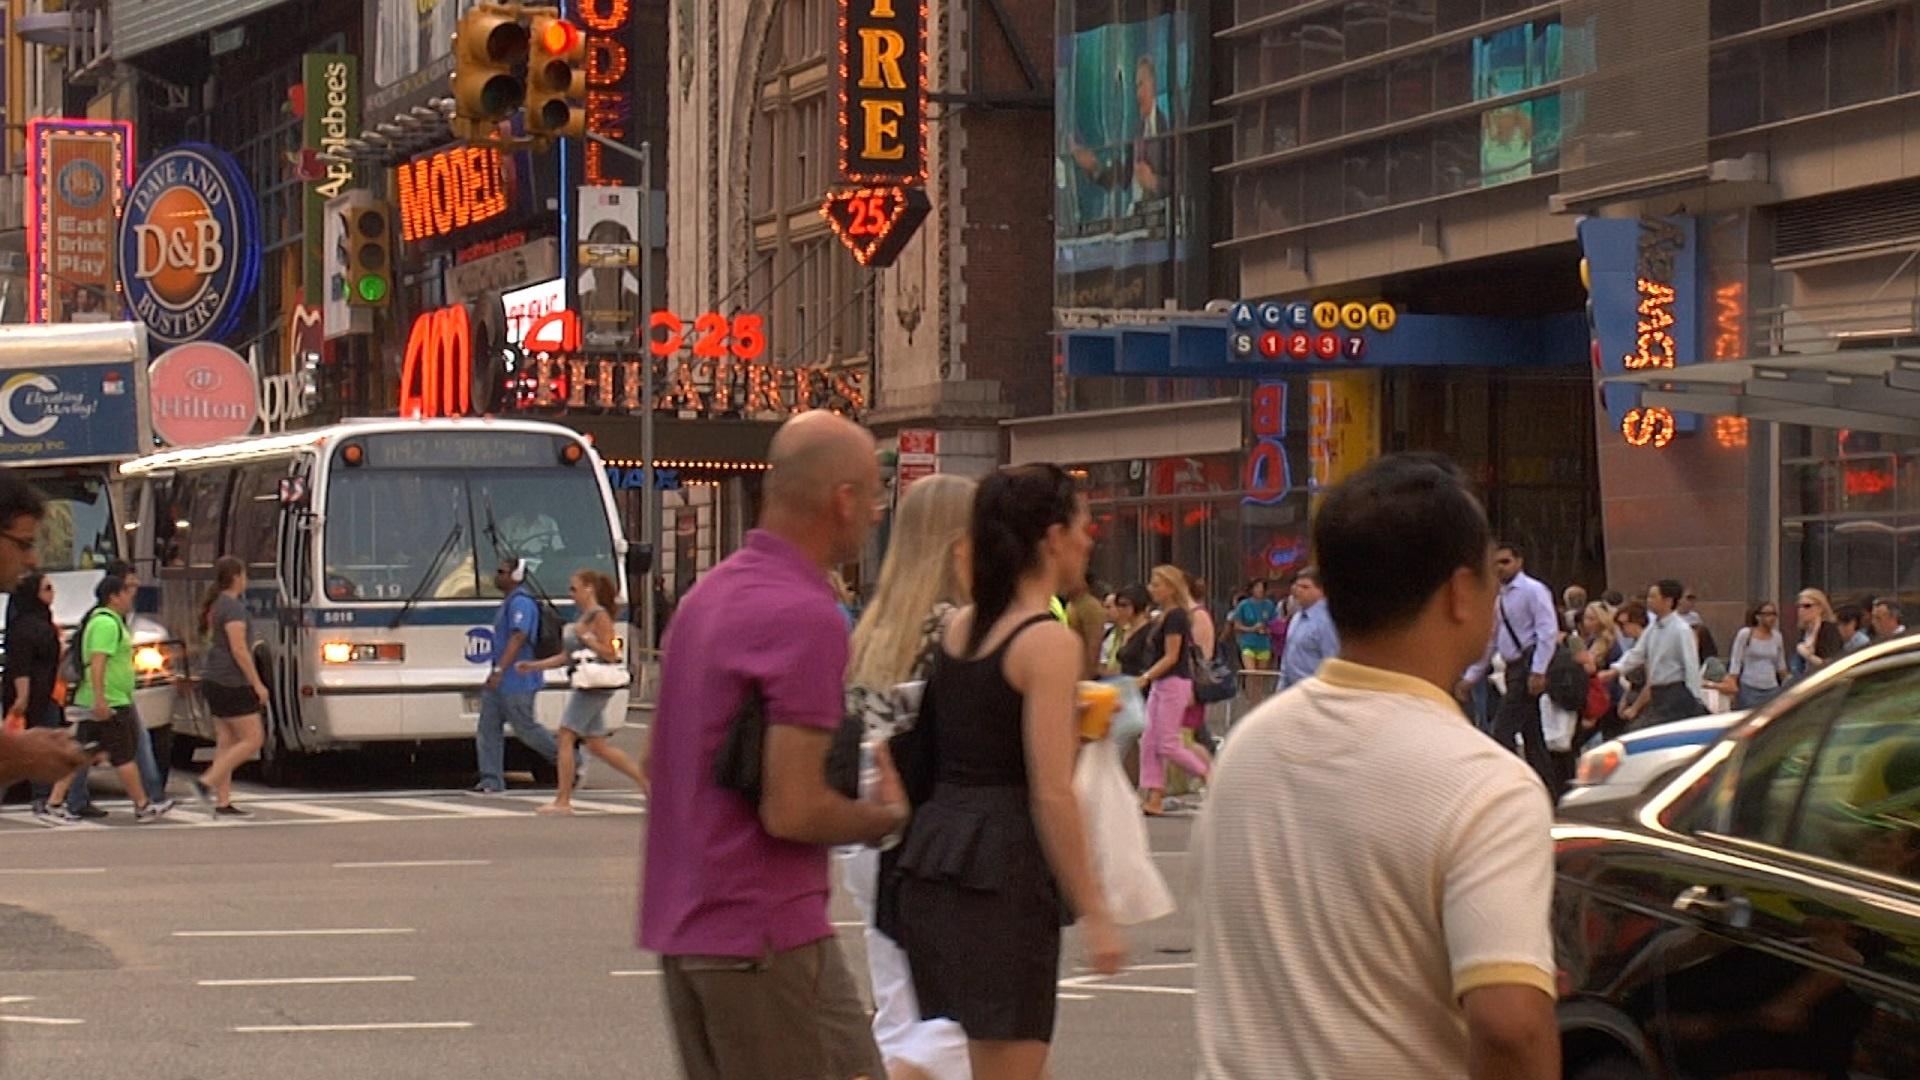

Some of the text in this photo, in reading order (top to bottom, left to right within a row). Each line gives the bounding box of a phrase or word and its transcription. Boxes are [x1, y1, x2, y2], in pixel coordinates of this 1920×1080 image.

[134, 159, 177, 214] DAVE
[182, 160, 222, 206] AND
[57, 216, 106, 233] Eat
[847, 198, 887, 236] 25
[133, 217, 224, 279] D&B
[693, 313, 766, 359] 25
[159, 397, 247, 420] Hilton
